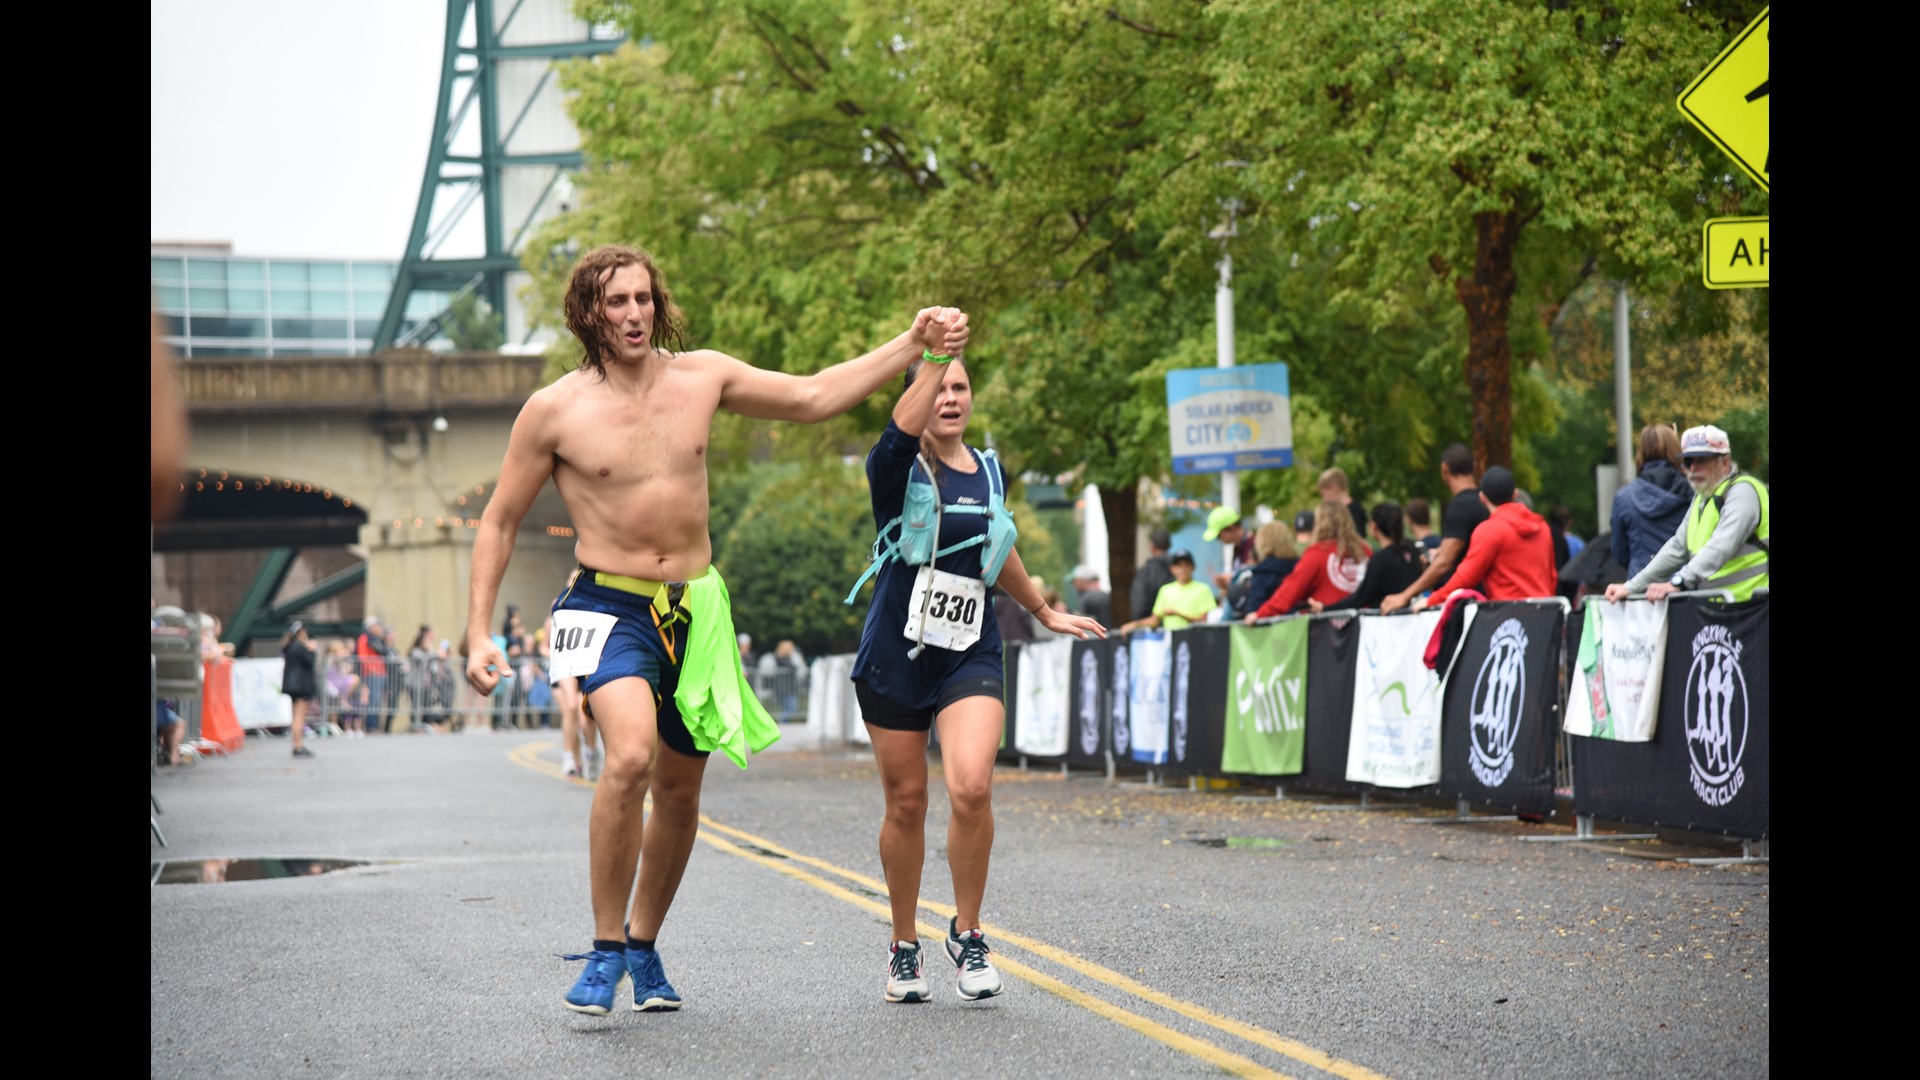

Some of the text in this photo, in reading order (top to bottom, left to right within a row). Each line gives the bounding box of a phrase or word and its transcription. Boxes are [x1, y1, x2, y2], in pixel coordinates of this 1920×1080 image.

[1185, 399, 1274, 419] SOLAR AMERICA
[1186, 422, 1222, 445] CITY
[920, 589, 977, 625] 1330
[554, 626, 597, 653] 401
[1692, 624, 1744, 662] KNOXVILLE
[1492, 751, 1514, 788] CLUB
[1689, 763, 1745, 807] TRACK CLUB
